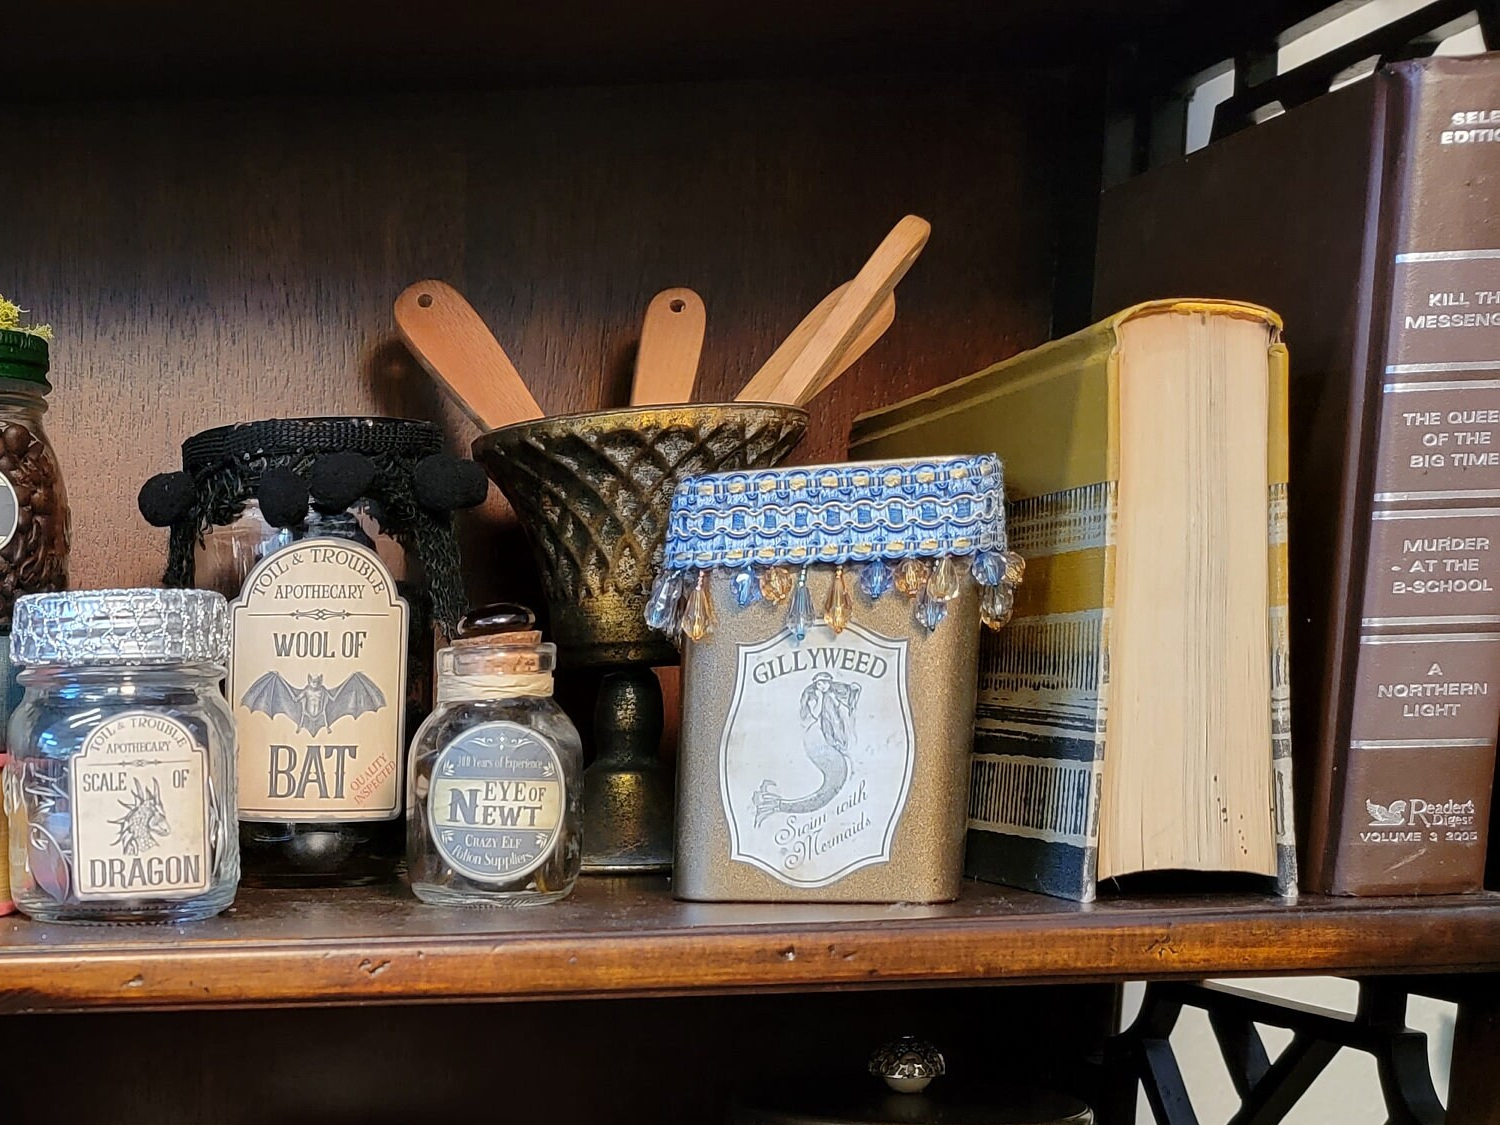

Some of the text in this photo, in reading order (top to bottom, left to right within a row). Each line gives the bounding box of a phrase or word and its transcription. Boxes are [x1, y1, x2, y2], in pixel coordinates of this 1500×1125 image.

[1428, 293, 1469, 307] KILL
[1403, 412, 1441, 426] THE
[1423, 432, 1491, 446] OF THE
[1410, 453, 1499, 468] BIG TIME
[1403, 537, 1489, 553] MURDER
[252, 549, 386, 597] TOIL & TROUBLE
[1409, 559, 1479, 573] AT THE
[274, 584, 366, 600] APOTHECARY
[1392, 579, 1493, 594] B-SCHOOL
[273, 631, 367, 658] WOOL OF
[752, 647, 888, 685] GILLYWEED
[1427, 663, 1443, 676] A
[1377, 683, 1487, 698] NORTHERN
[1403, 703, 1461, 717] LIGHT
[90, 718, 187, 751] TOIL TROUBLE
[106, 741, 171, 754] APOTHECARY
[268, 744, 358, 799] BAT
[350, 752, 388, 792] QUALITY
[83, 770, 190, 793] SCALE OF
[354, 760, 396, 807] INSPECTED
[483, 781, 547, 802] EYE OF
[446, 788, 543, 827] NEWT
[774, 779, 868, 846] Swim with
[1432, 815, 1473, 828] Digest
[465, 834, 523, 849] CRAZY ELF
[784, 811, 872, 870] Mermaids
[1360, 831, 1422, 842] VOLUME
[483, 852, 534, 871] Suppliers
[90, 855, 200, 889] DRAGON
